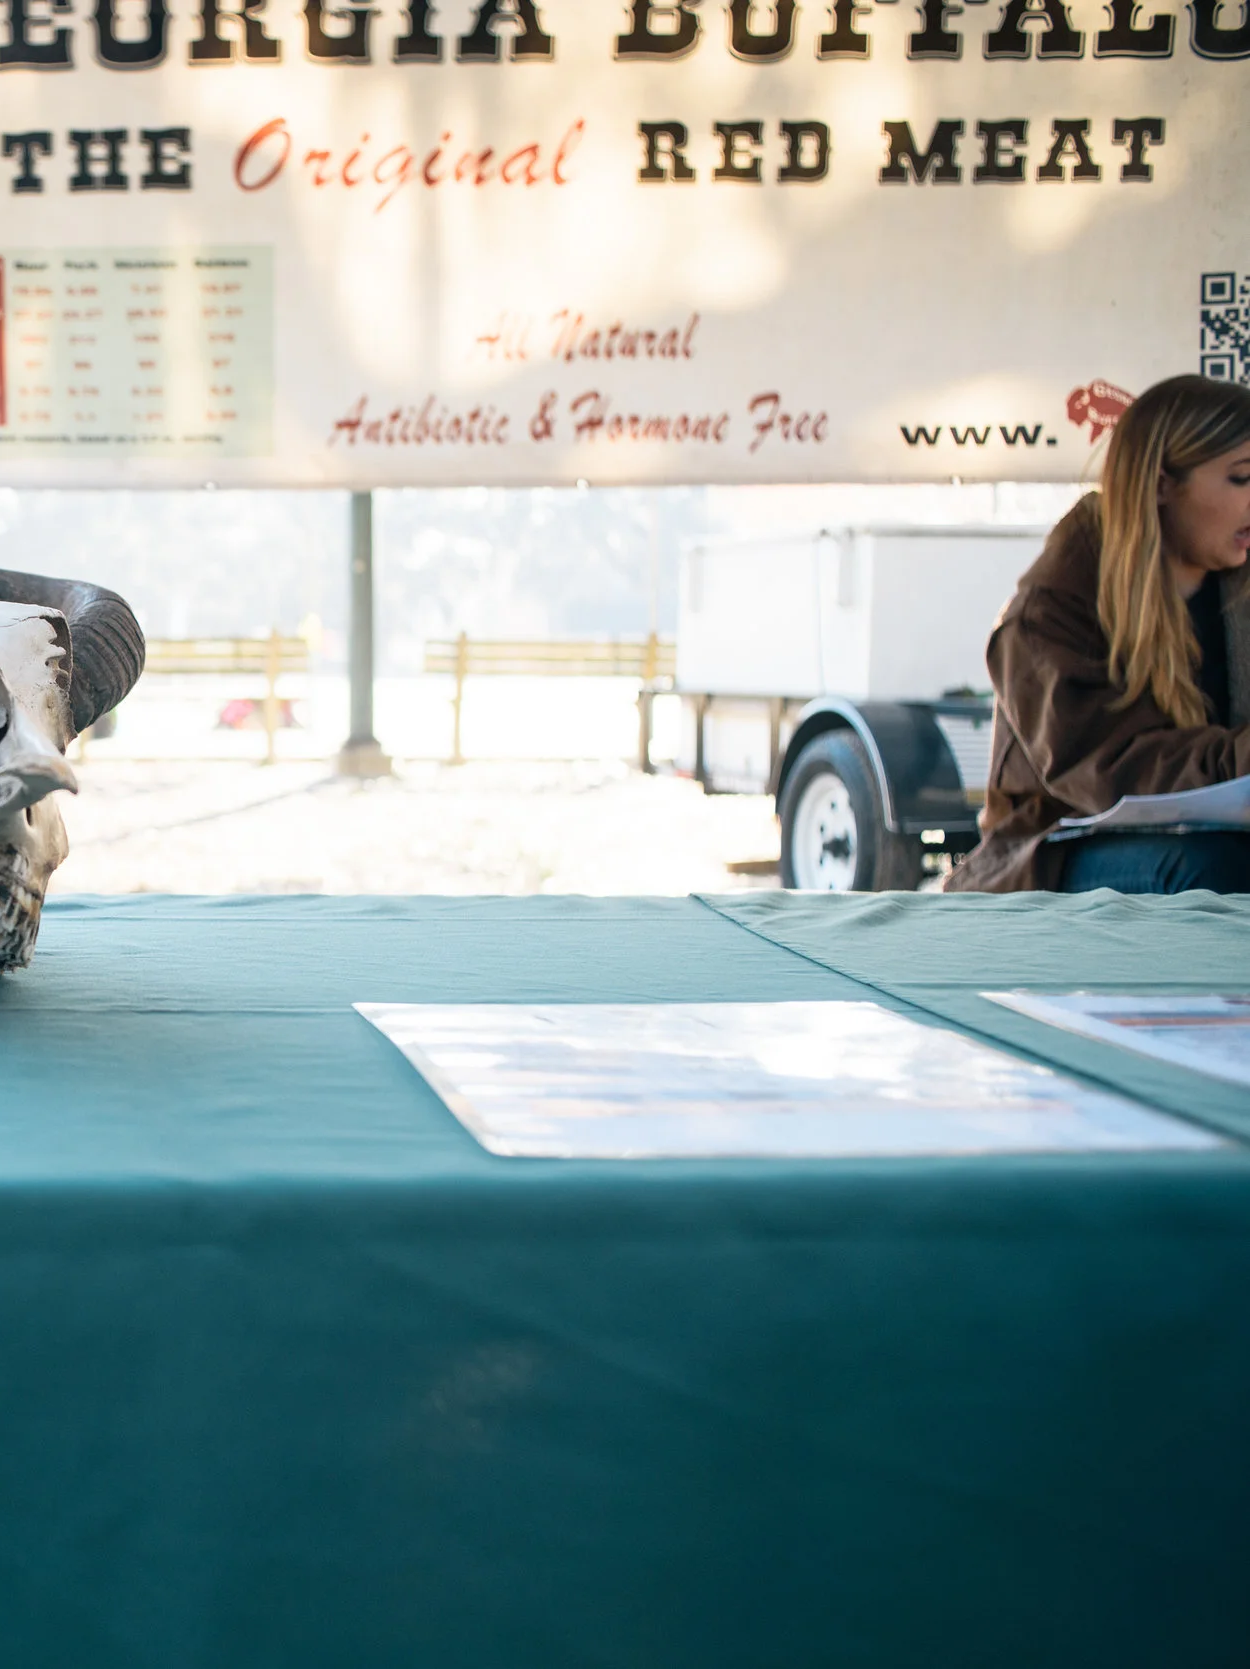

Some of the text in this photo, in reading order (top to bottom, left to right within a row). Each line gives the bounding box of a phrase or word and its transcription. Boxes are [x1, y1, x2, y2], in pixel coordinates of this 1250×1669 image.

[1, 117, 1166, 213] THE Original RED MEAT
[467, 307, 701, 364] All Natural
[327, 388, 830, 454] Antibiotic & Hormone Free
[900, 423, 1058, 447] www.
